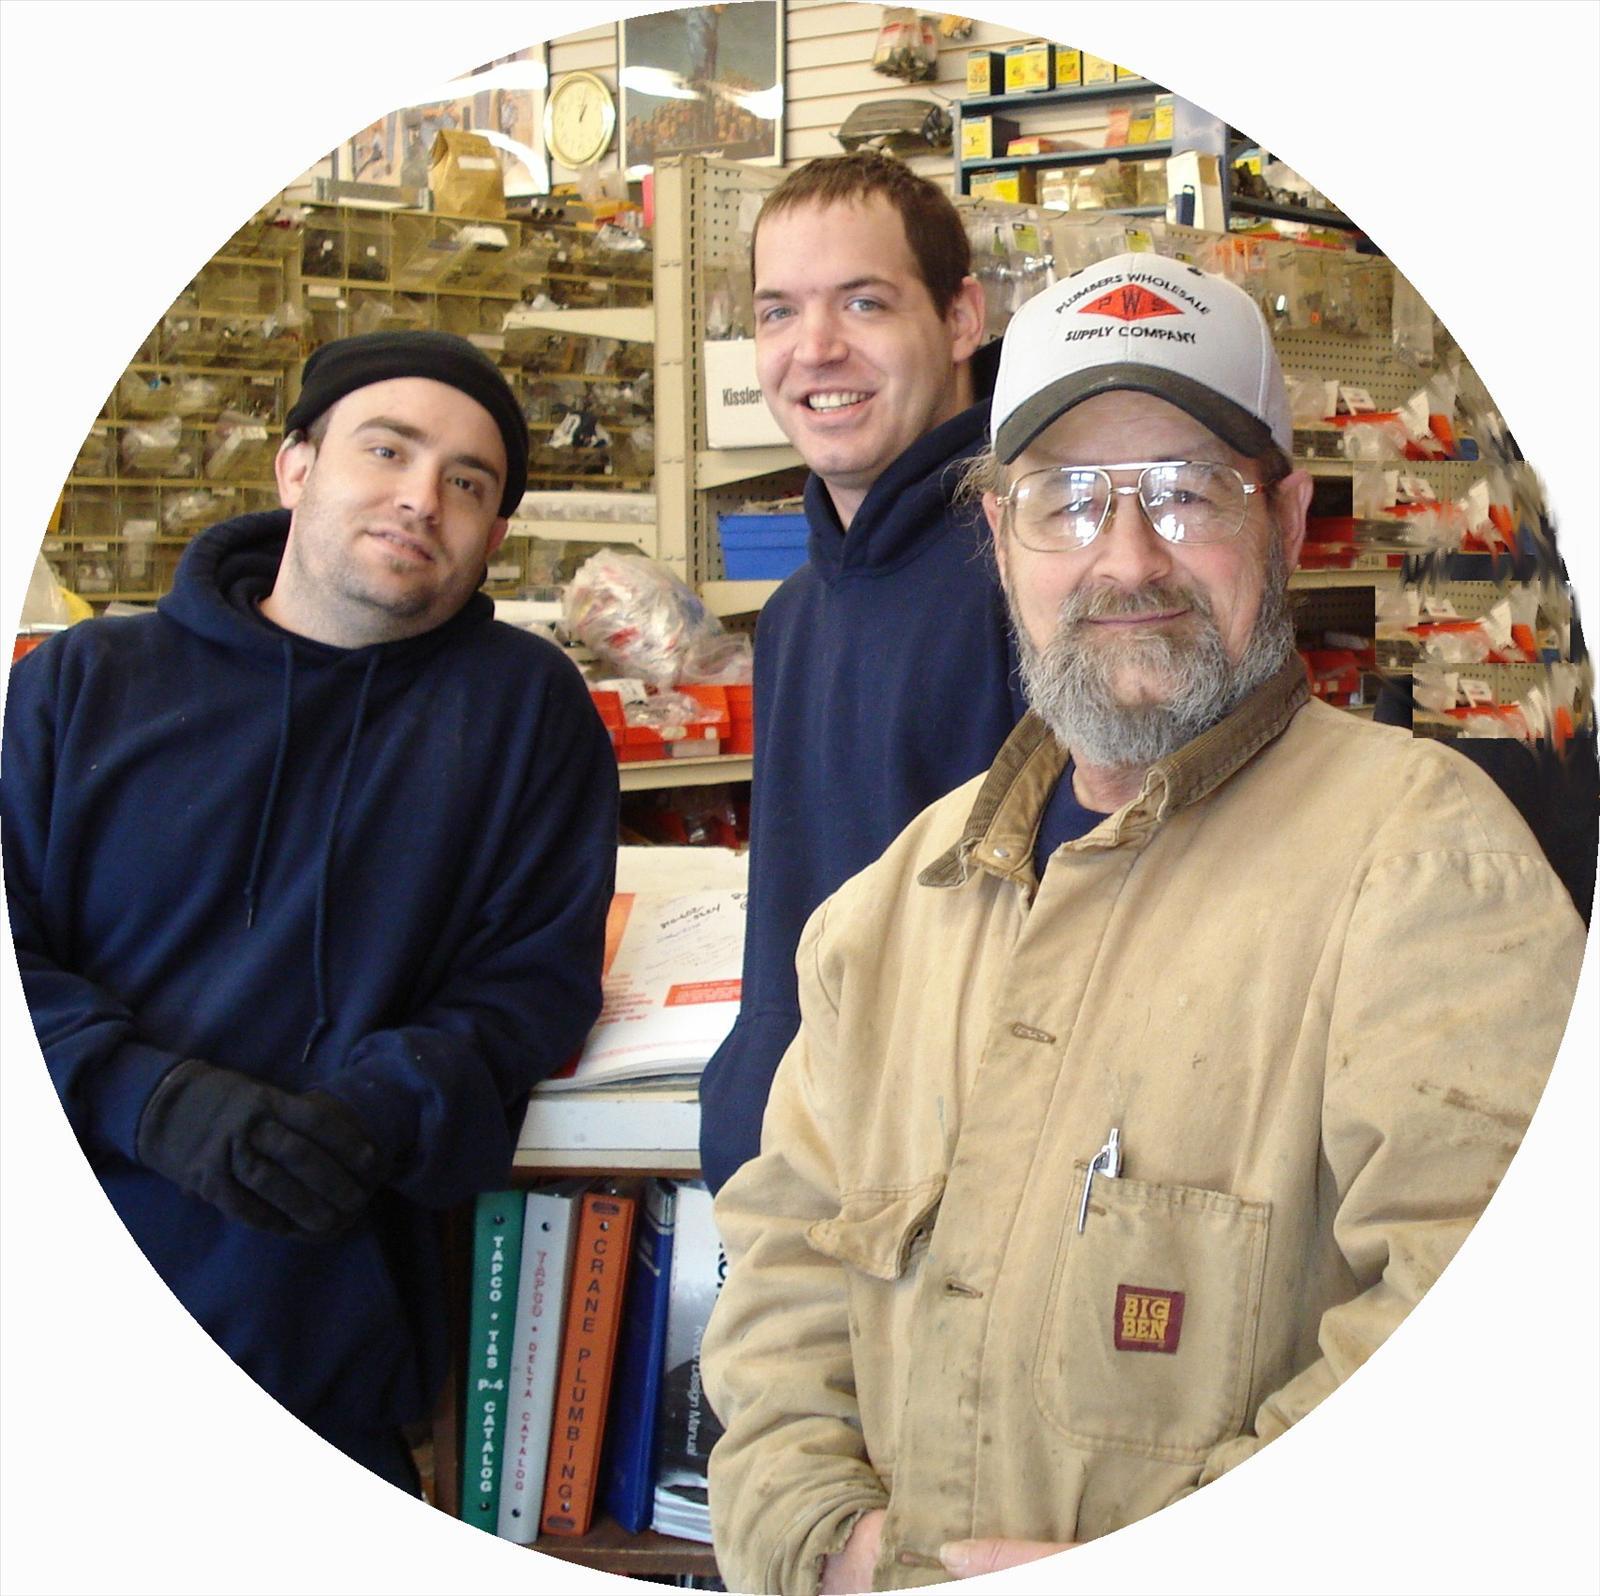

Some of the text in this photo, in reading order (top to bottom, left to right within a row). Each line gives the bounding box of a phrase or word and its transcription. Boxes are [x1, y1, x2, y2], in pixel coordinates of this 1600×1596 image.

[1056, 273, 1211, 315] PLUMBERS WHOLESALE
[1065, 326, 1196, 344] SUPPLY COMPANY
[722, 386, 762, 406] Kissler
[489, 1236, 504, 1302] TAPCO
[1123, 1293, 1171, 1321] BIG
[1121, 1318, 1168, 1342] BEN
[478, 1379, 504, 1391] P-4
[515, 1249, 547, 1490] TAPCO DELTA CATALOG
[558, 1239, 608, 1499] CRANE PLUMBING
[480, 1401, 496, 1492] CATALOG
[687, 1409, 701, 1456] Manual
